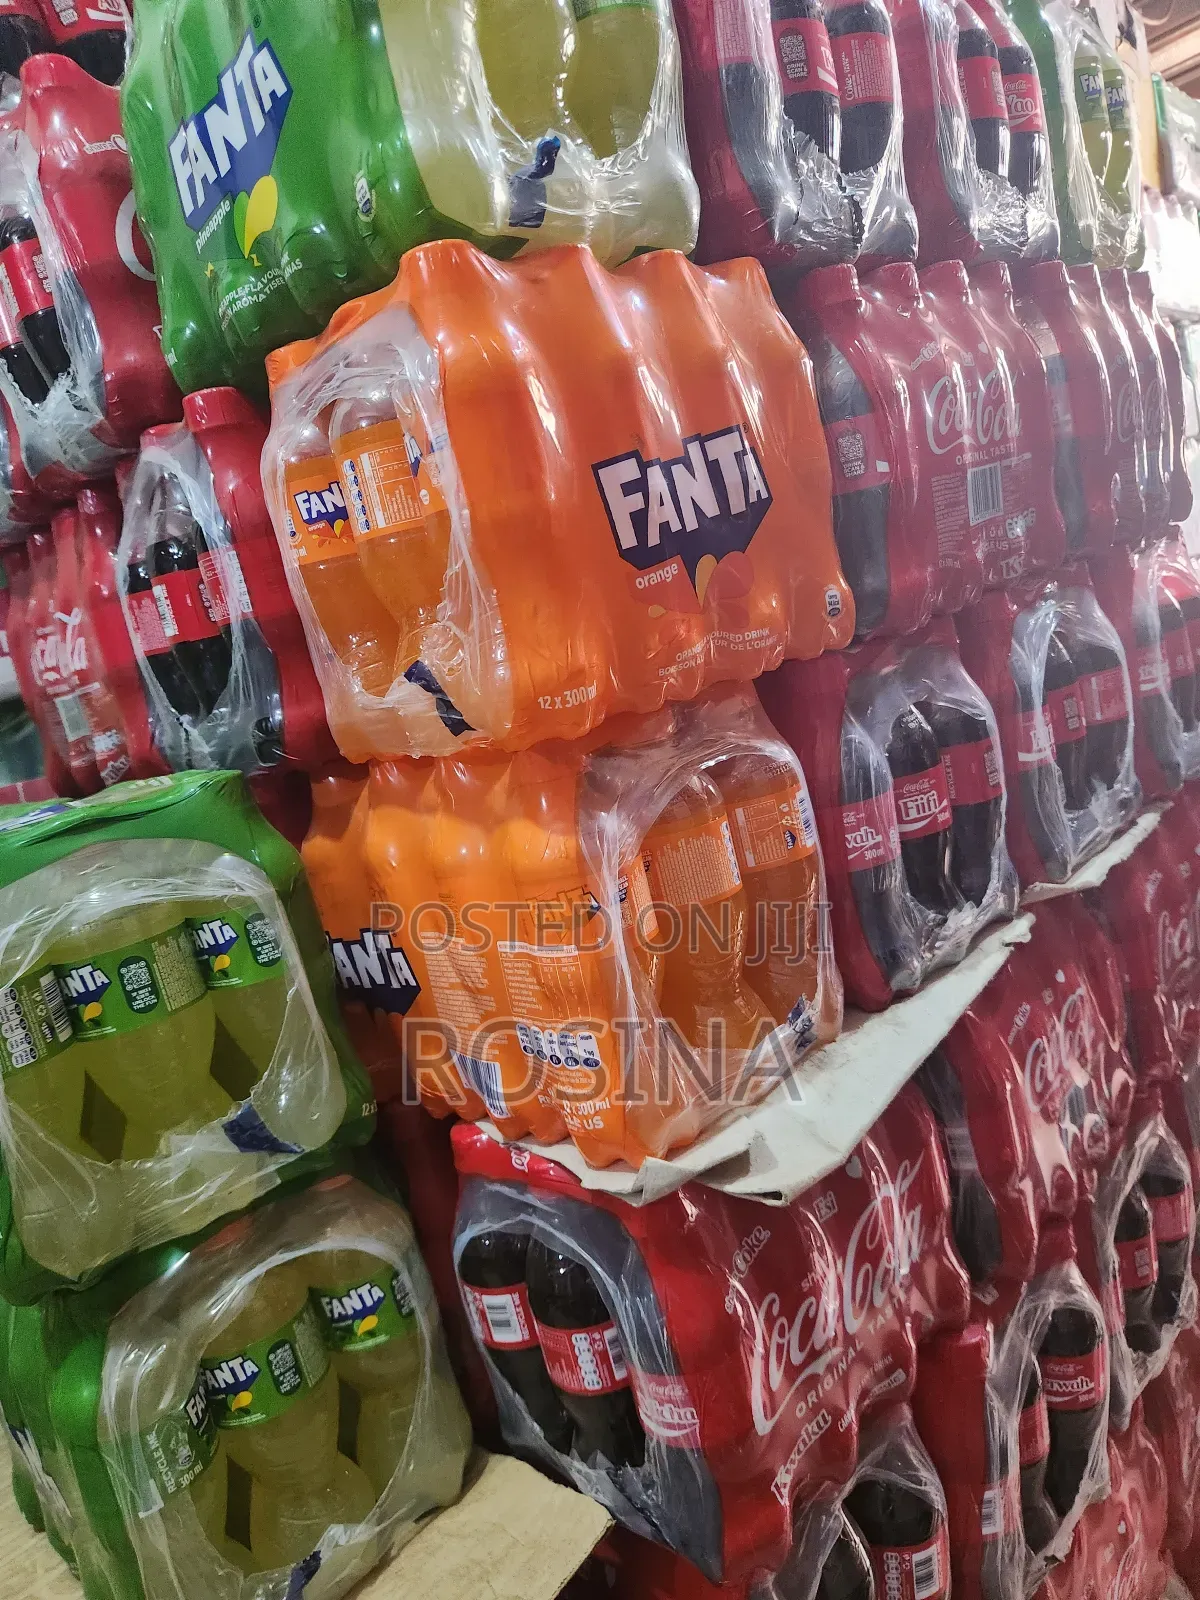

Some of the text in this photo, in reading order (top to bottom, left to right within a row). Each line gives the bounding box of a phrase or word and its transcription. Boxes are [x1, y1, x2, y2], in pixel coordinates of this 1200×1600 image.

[844, 75, 855, 101] Coke
[169, 33, 288, 218] FANTA
[194, 202, 232, 255] pineapple
[597, 430, 769, 550] FANTA
[635, 562, 680, 590] orange
[744, 626, 770, 641] DRINK
[658, 659, 696, 677] BOISSON
[730, 643, 745, 651] DE
[537, 679, 597, 710] 12 x 300 ml
[903, 778, 931, 794] Coca-Cola
[899, 791, 939, 821] Fiifi
[192, 919, 238, 950] ANTA
[325, 931, 417, 989] ANTA
[60, 964, 111, 998] ANTA
[577, 1101, 596, 1115] 300
[596, 1097, 611, 1111] ml
[583, 1115, 605, 1130] US
[732, 1224, 771, 1279] Coke
[795, 1340, 865, 1420] ORIGINAL
[153, 1447, 178, 1495] RECYCLE
[178, 1472, 195, 1489] 300
